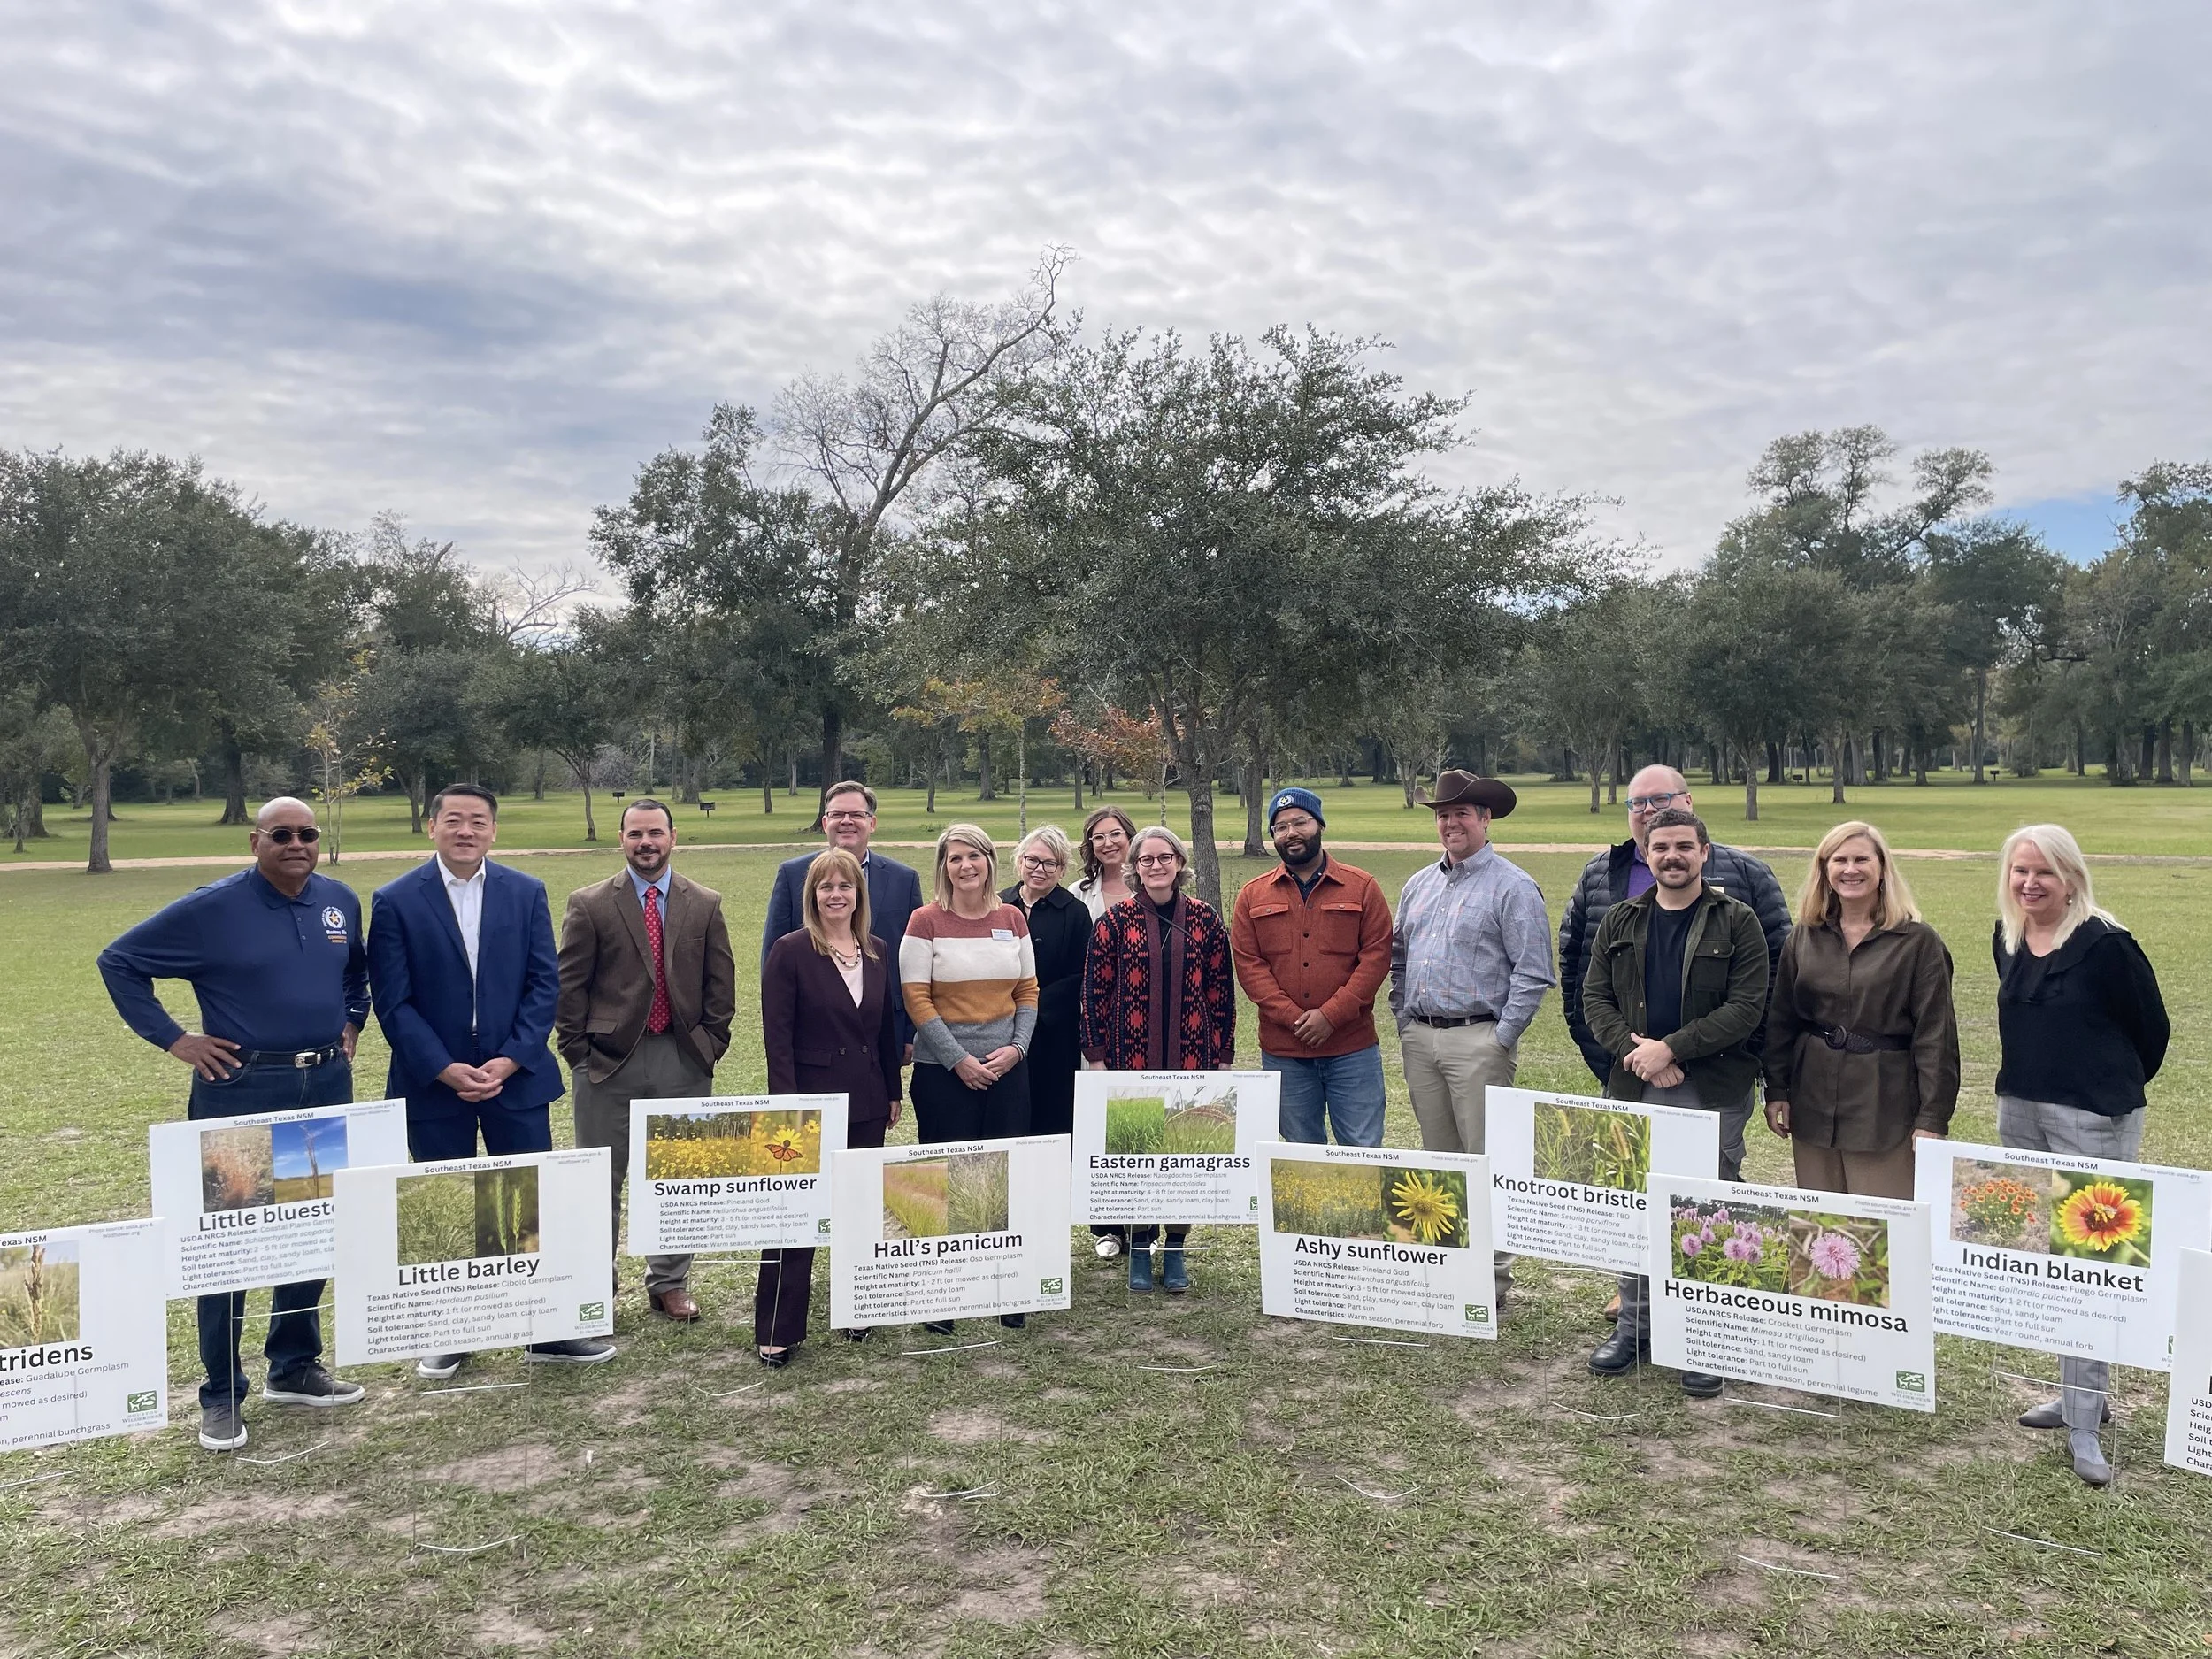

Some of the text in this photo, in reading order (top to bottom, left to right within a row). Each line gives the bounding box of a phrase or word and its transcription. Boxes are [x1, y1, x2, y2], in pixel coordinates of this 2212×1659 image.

[1555, 1097, 1589, 1107] Southeast
[234, 1116, 272, 1126] Southeast
[296, 1111, 314, 1120] NSM
[908, 1148, 944, 1156] Southeast
[1325, 1149, 1360, 1158] Southeast
[2005, 1152, 2098, 1170] Southeast Texas NSM
[425, 1163, 465, 1173] Southeast
[492, 1159, 511, 1168] NSM
[1090, 1155, 1250, 1171] Eastern gamagrass
[654, 1179, 817, 1197] Swamp sunflower
[1494, 1174, 1647, 1210] Knotroot bristle
[1731, 1187, 1819, 1202] Southeast Texas NSM
[1507, 1196, 1525, 1205] Texas
[1526, 1199, 1548, 1208] Native
[1566, 1205, 1585, 1214] (TNS)
[199, 1200, 334, 1232] Little bluest
[25, 1234, 47, 1244] NSM
[937, 1234, 1023, 1257] panicum
[1295, 1238, 1448, 1265] Ashy sunflower
[1561, 1249, 1579, 1258] Warm
[1607, 1257, 1640, 1267] perennial
[399, 1258, 540, 1286] Little barley
[918, 1258, 938, 1267] (TNS)
[1362, 1265, 1391, 1274] Pineland
[1962, 1248, 2144, 1292] Indian blanket
[392, 1290, 419, 1299] Native
[442, 1285, 465, 1294] (TNS)
[501, 1279, 526, 1287] Cibolo
[527, 1275, 572, 1285] Germplasm
[1955, 1267, 1981, 1279] Native
[1983, 1271, 2004, 1281] Seed
[2006, 1275, 2029, 1286] (TNS)
[2069, 1285, 2095, 1296] Fuego
[2097, 1289, 2148, 1303] Germplasm
[958, 1302, 991, 1312] perennial
[1665, 1280, 1908, 1333] Herbaceous mimosa
[2008, 1296, 2021, 1305] 1-2
[2032, 1300, 2043, 1309] (or
[2046, 1303, 2078, 1314] mowed
[2091, 1310, 2127, 1323] desired)
[367, 1325, 382, 1333] Soil
[472, 1313, 495, 1322] sandy
[1686, 1306, 1708, 1316] USDA
[1709, 1310, 1731, 1319] NRCS
[1768, 1318, 1801, 1330] Crockett
[1804, 1324, 1852, 1337] Germplasm
[1686, 1317, 1723, 1328] Scientific
[1750, 1326, 1782, 1338] Mimosa
[1784, 1332, 1824, 1344] strigillosa
[1934, 1317, 1993, 1333] haracteristics:
[1994, 1326, 2013, 1336] Year
[2044, 1336, 2072, 1347] annual
[2075, 1340, 2093, 1350] forb
[0, 1344, 94, 1372] tridens
[1767, 1351, 1791, 1362] sandy
[1793, 1354, 1814, 1364] loam
[26, 1362, 129, 1382] Guadalupe Germplasm
[1749, 1369, 1772, 1379] Warm
[1806, 1379, 1845, 1391] perennial
[1847, 1385, 1878, 1396] legume
[2, 1397, 35, 1409] mowed
[50, 1390, 88, 1402] desired)
[12, 1424, 111, 1446] perennial bunchgrass
[2188, 1432, 2207, 1445] Soil
[2187, 1444, 2212, 1458] Light
